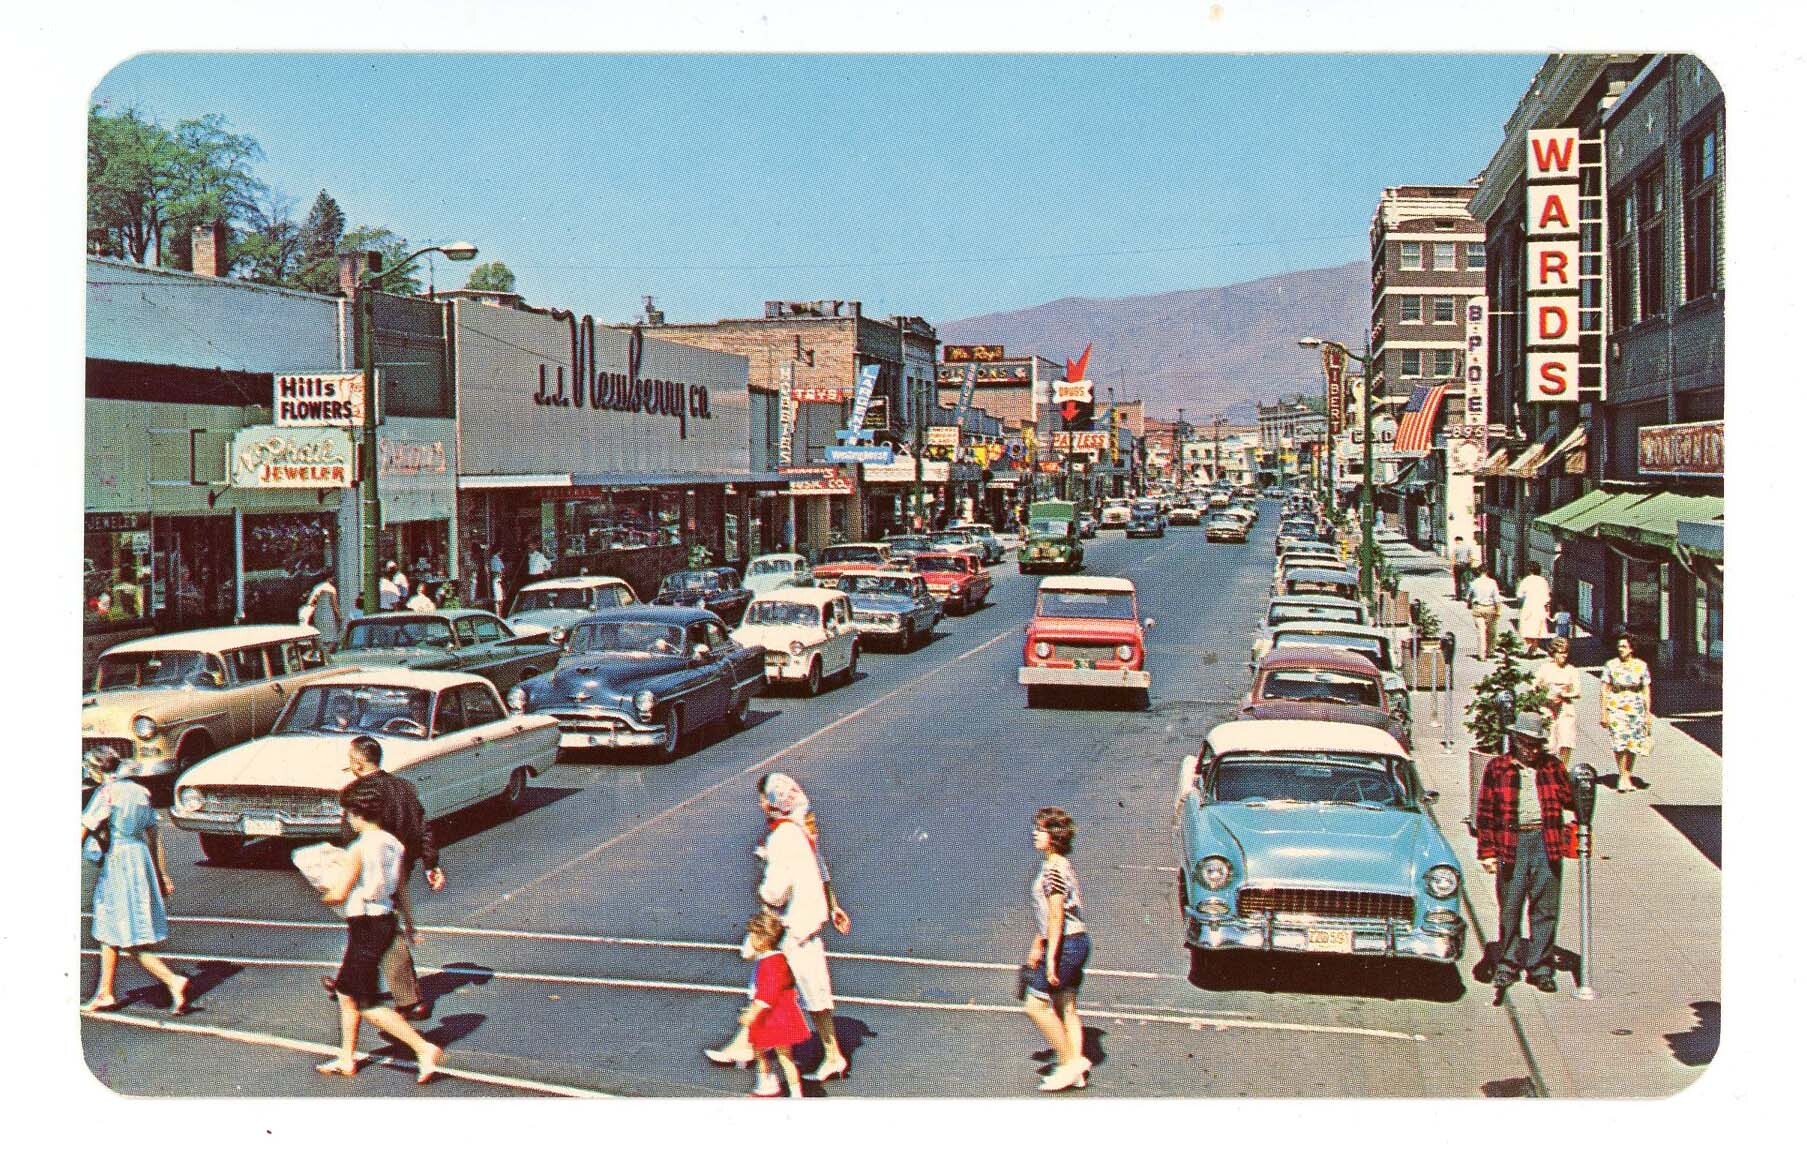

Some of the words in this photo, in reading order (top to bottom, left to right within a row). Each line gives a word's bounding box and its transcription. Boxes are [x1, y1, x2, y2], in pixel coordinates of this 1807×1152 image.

[1531, 136, 1575, 397] WARDS
[279, 376, 336, 397] Hills
[1058, 385, 1086, 398] DRUGS
[280, 400, 353, 421] FLOWERS
[1076, 431, 1105, 448] LESS
[1452, 426, 1485, 438] 896
[259, 464, 346, 483] JEWELER
